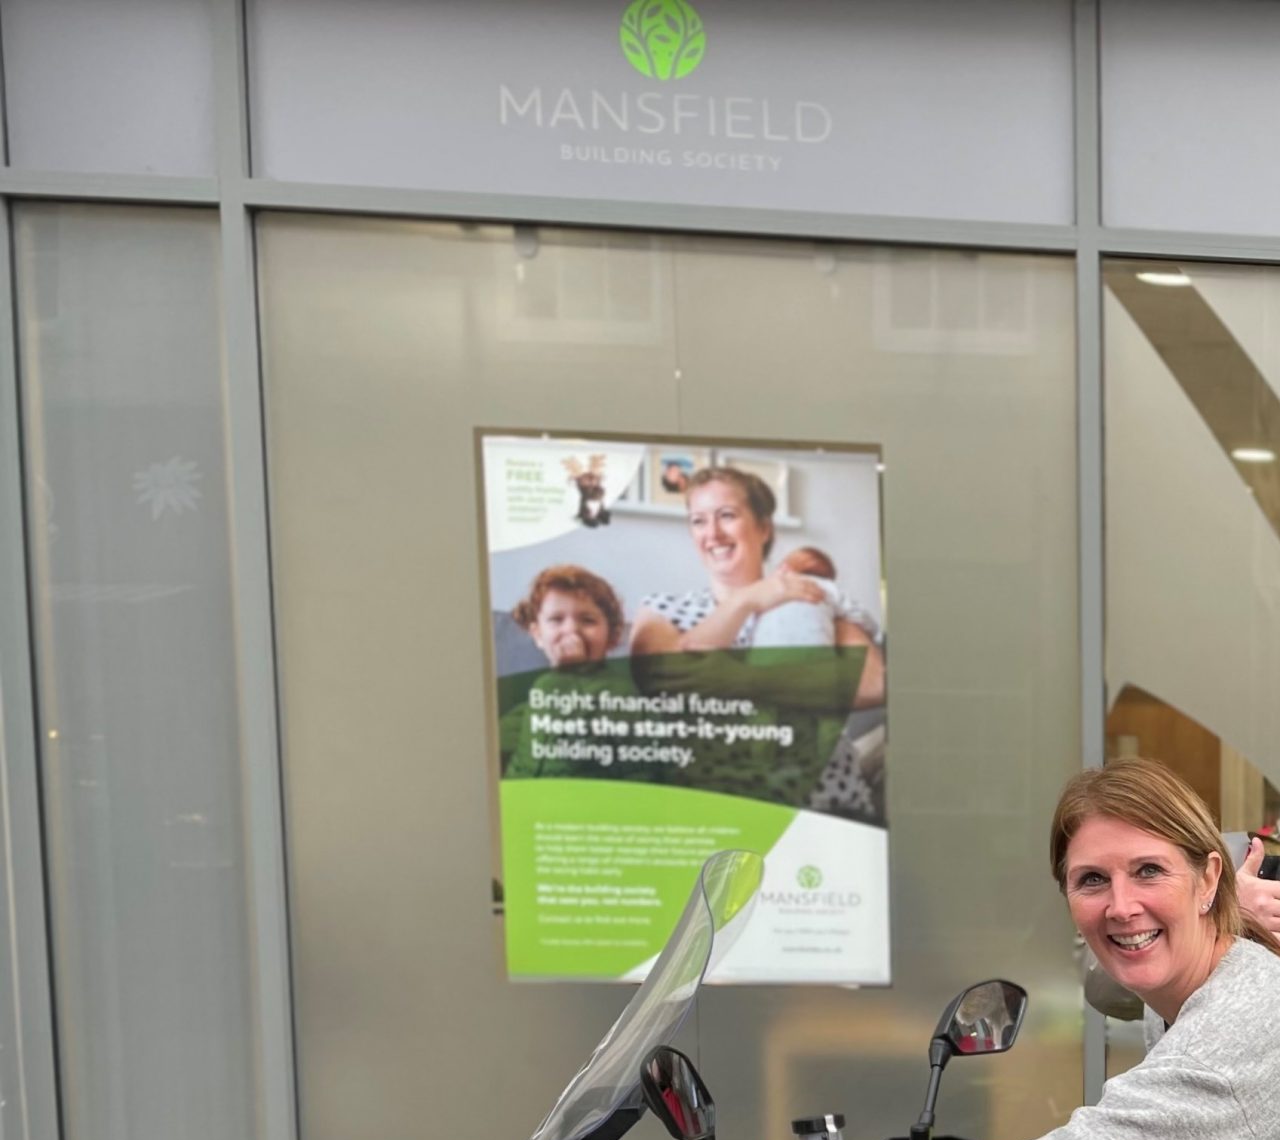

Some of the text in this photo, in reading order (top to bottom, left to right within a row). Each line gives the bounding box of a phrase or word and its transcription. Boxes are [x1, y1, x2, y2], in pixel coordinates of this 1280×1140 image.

[499, 84, 833, 143] MANSFIELD
[560, 144, 782, 172] BUILDING SOCIETY
[529, 689, 758, 716] Bright financial future.
[530, 714, 794, 746] Meet the start-it-young
[531, 739, 696, 768] building society.
[760, 892, 862, 907] MANSFIELD
